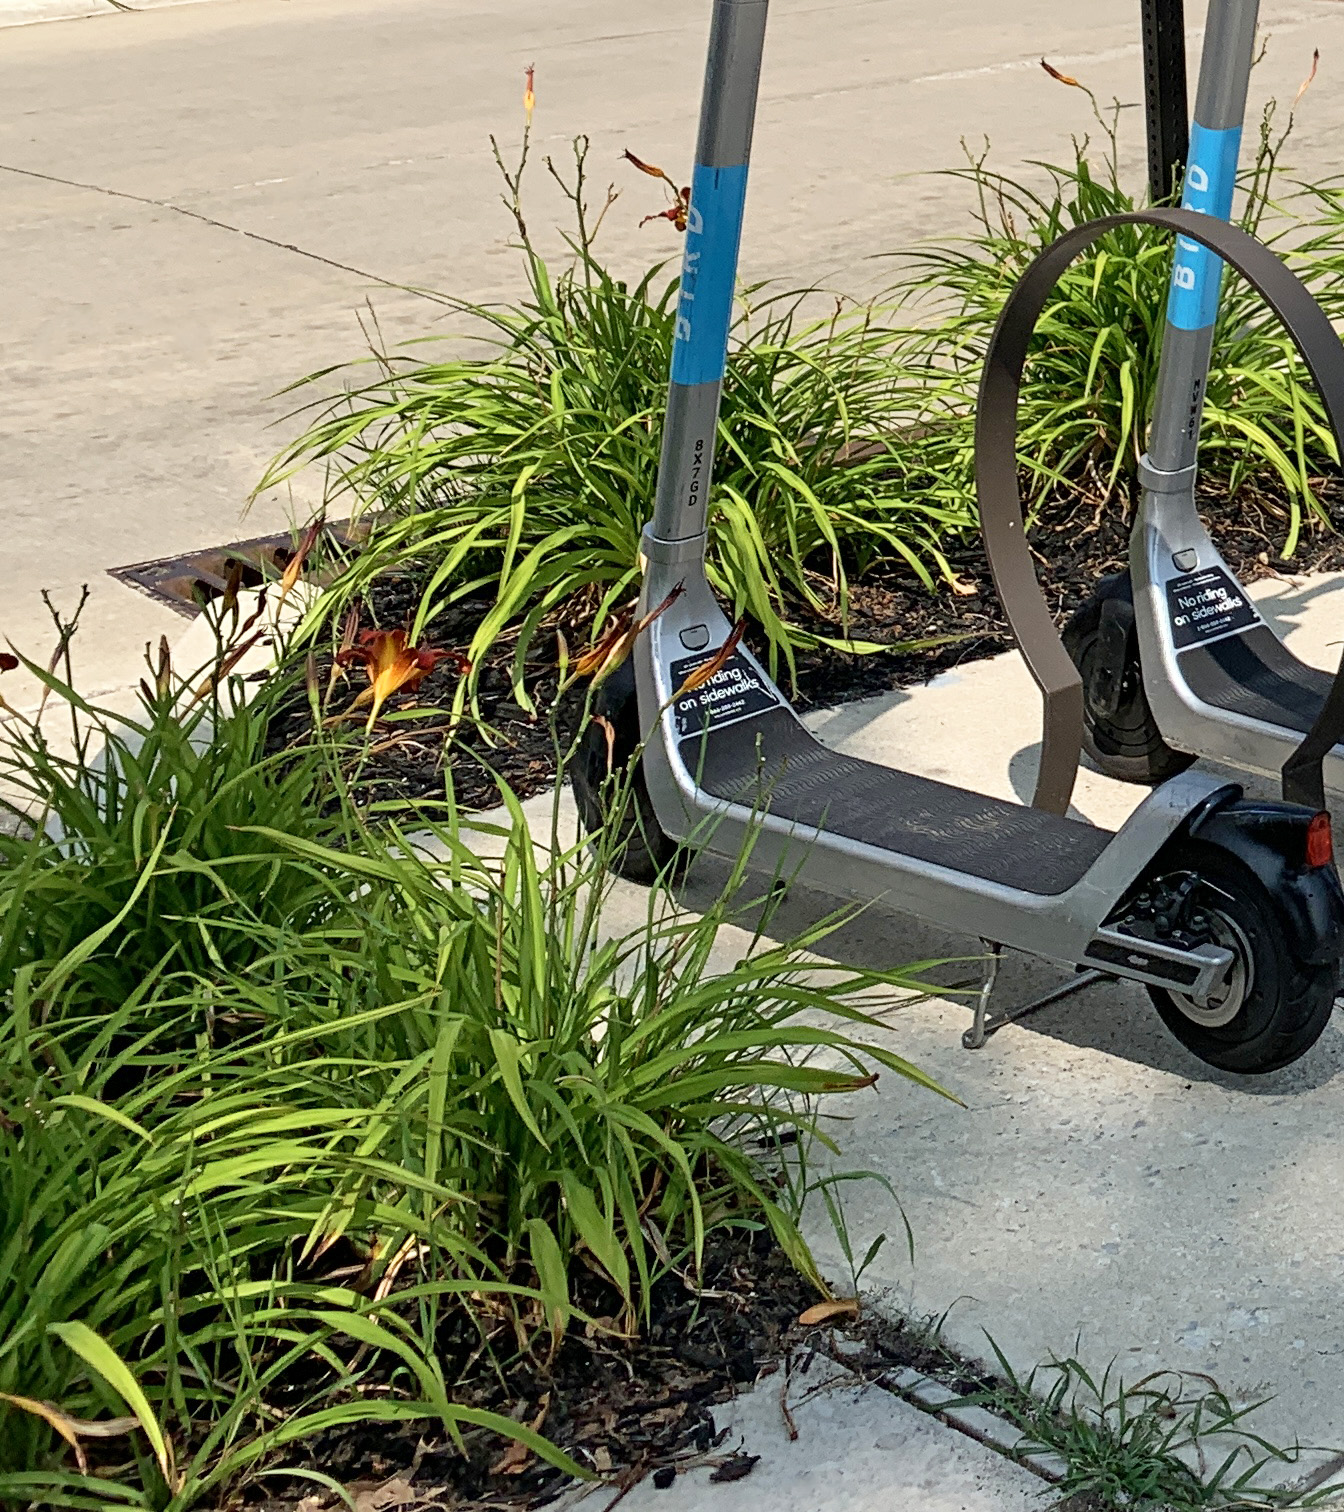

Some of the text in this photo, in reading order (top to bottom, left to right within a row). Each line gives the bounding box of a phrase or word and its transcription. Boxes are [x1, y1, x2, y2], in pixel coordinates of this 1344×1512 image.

[688, 439, 704, 507] 8X7GD
[1173, 613, 1191, 626] on
[1191, 595, 1243, 620] sidewalks
[1177, 587, 1228, 610] No riding
[678, 697, 698, 712] on
[699, 677, 760, 706] sidewalks
